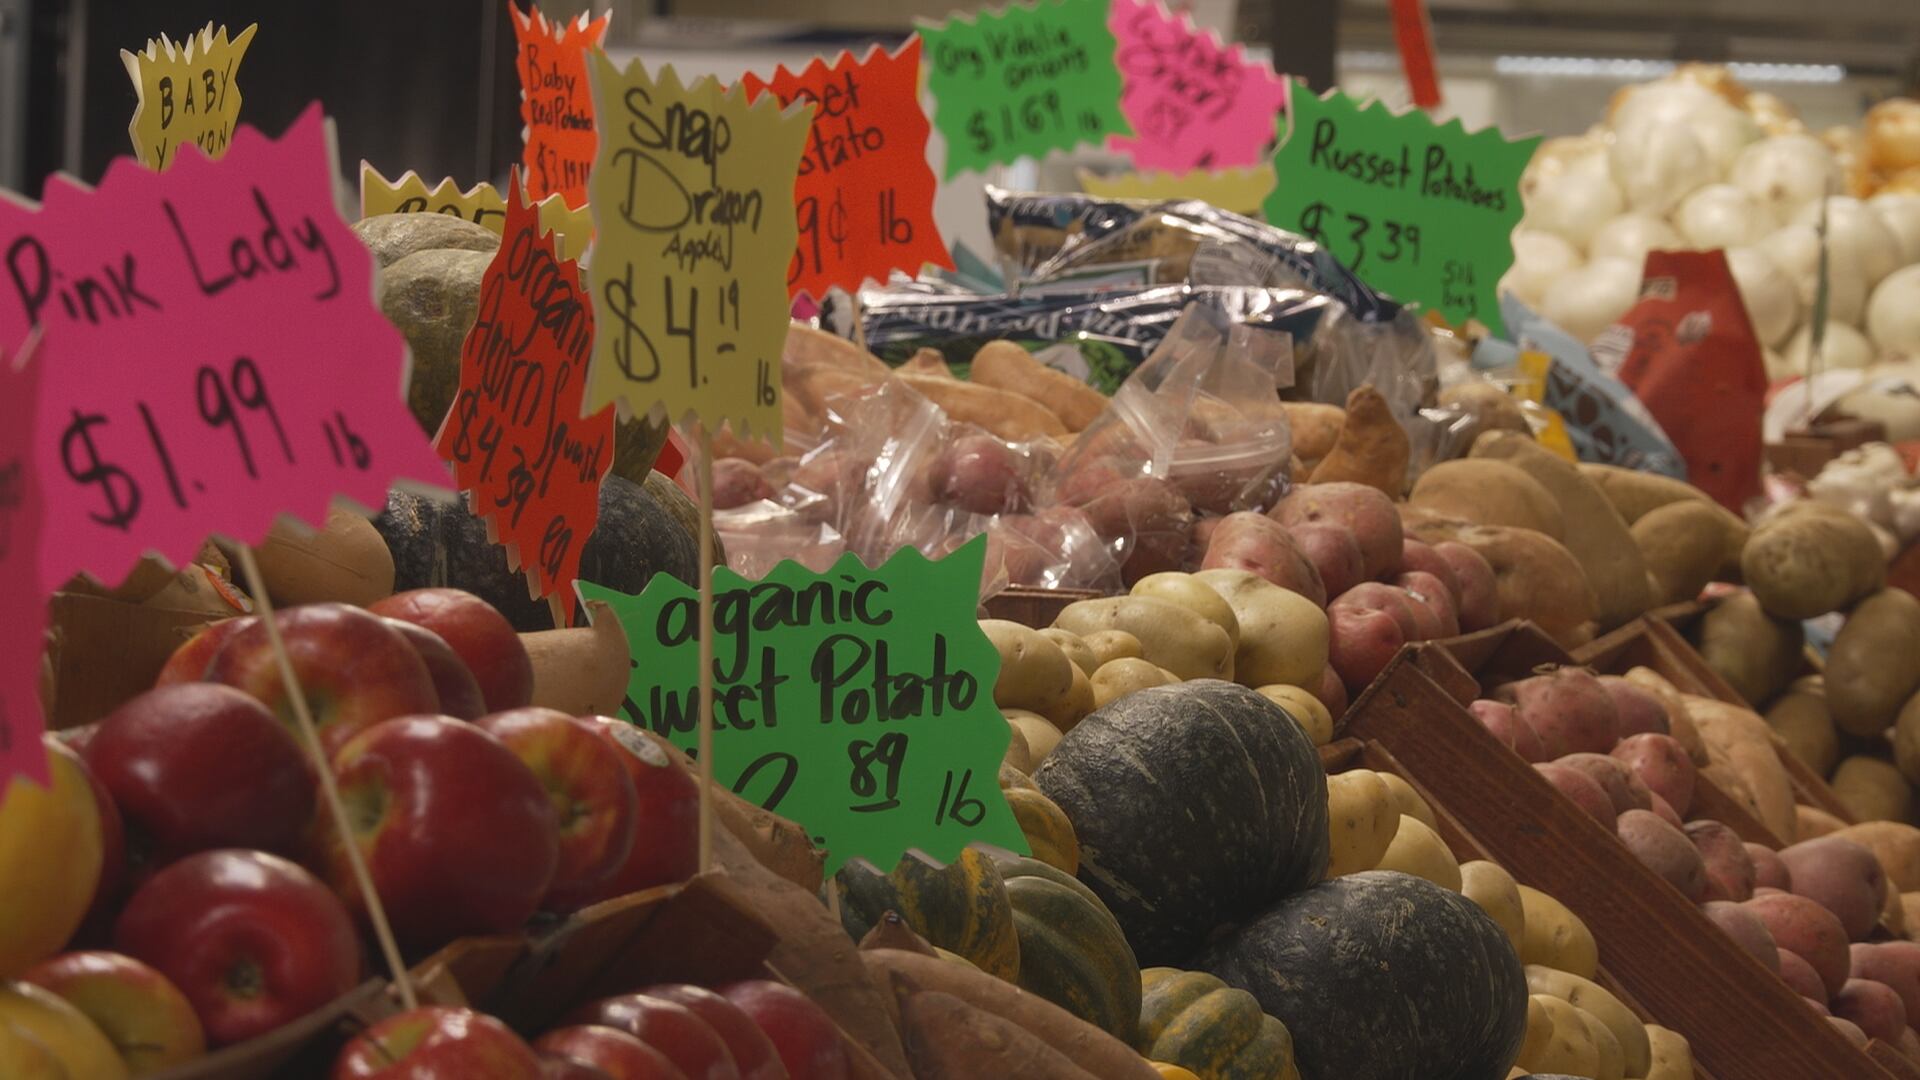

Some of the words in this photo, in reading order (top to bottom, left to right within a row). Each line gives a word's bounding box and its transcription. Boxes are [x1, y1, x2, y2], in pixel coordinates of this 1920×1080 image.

[159, 57, 233, 130] BABY
[527, 43, 576, 99] Baby
[624, 86, 732, 190] Snap
[797, 115, 884, 177] otato
[1309, 117, 1414, 191] Russet
[612, 147, 763, 262] Dragon
[878, 187, 914, 246] lb
[6, 235, 161, 327] Pink
[162, 186, 342, 301] Lady
[507, 225, 594, 364] Organi
[757, 358, 777, 408] lb
[60, 356, 297, 533] $1.99
[323, 411, 371, 471] lb
[811, 633, 977, 724] Potato
[935, 769, 986, 827] lb
